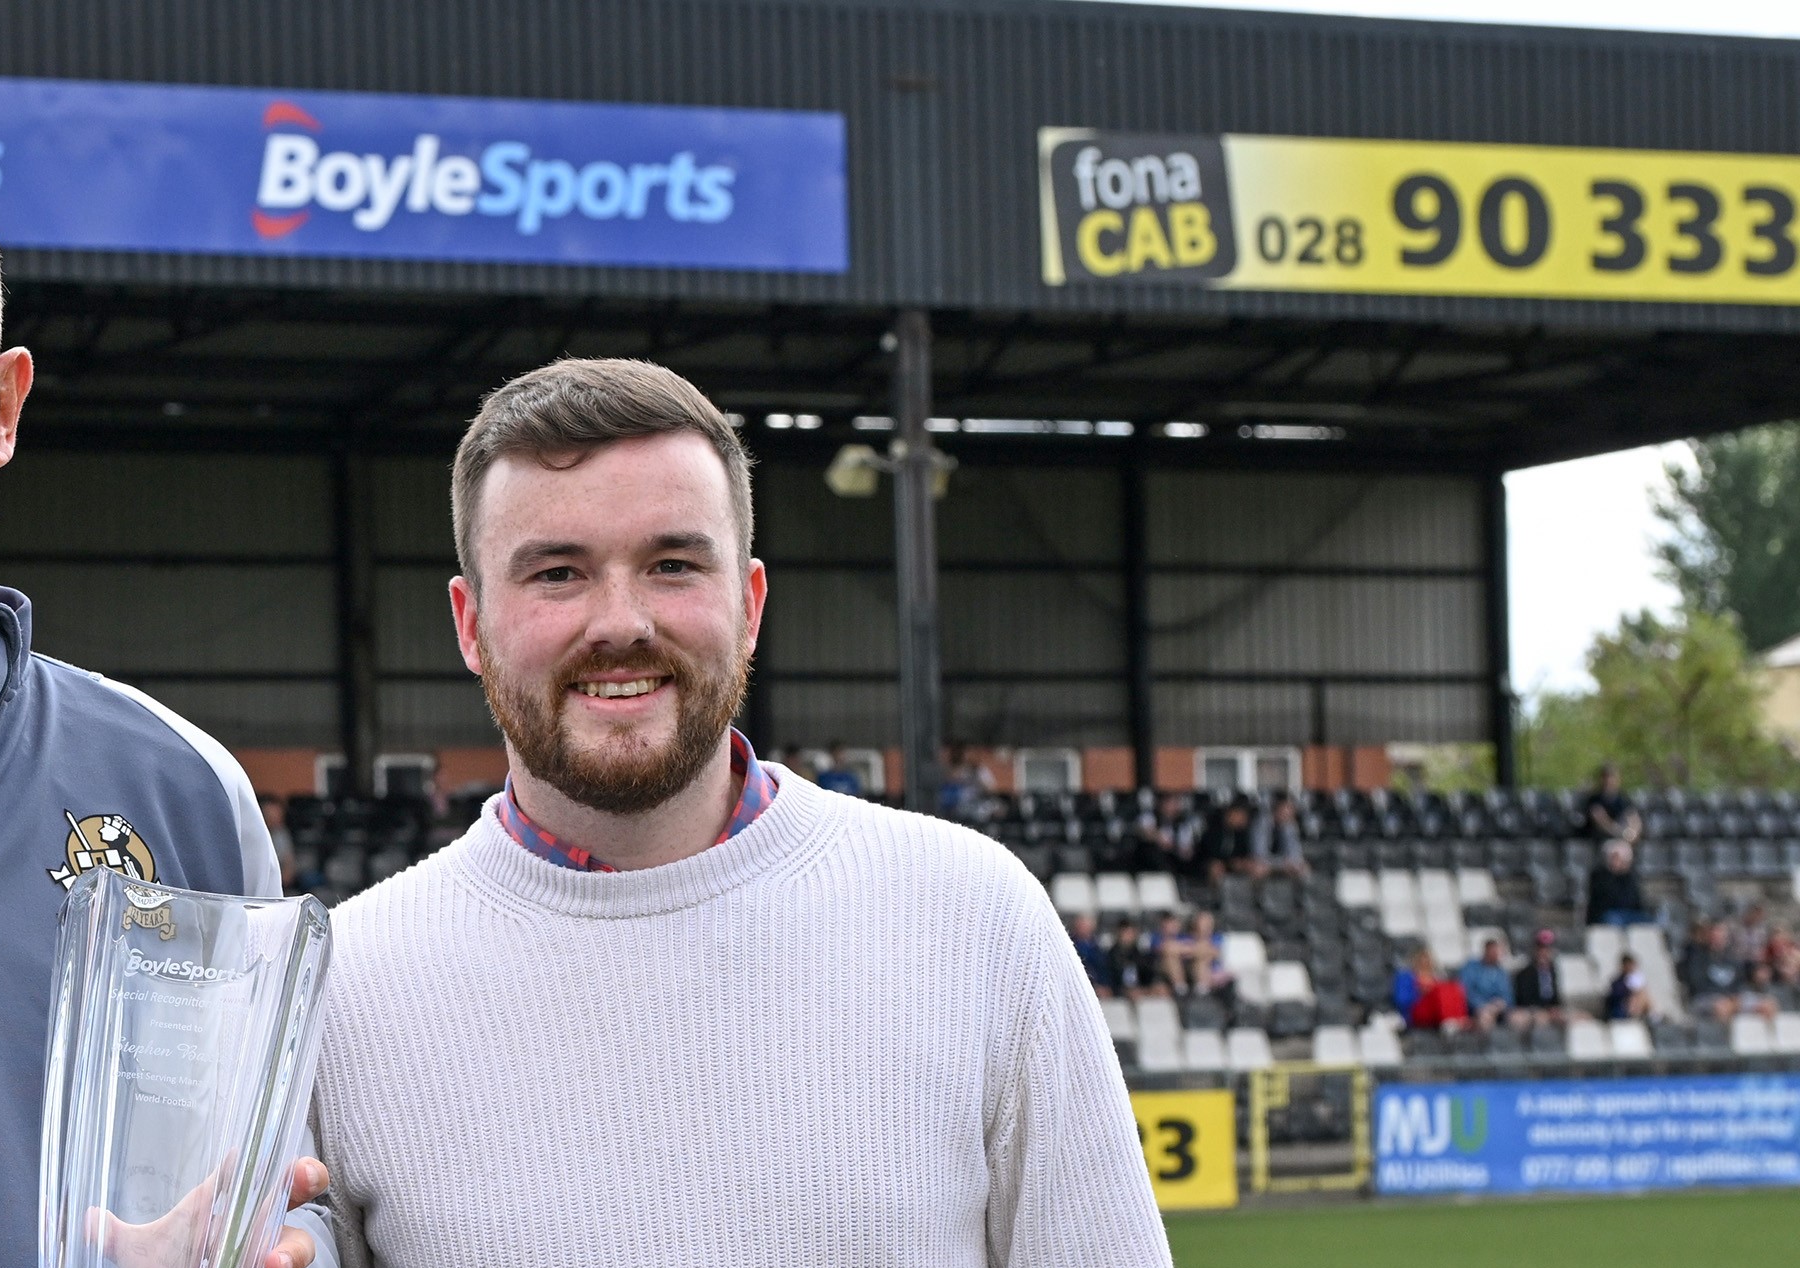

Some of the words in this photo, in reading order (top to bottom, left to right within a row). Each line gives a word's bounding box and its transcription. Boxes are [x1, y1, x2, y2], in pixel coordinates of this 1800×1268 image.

[257, 134, 736, 236] BoyleSports
[1073, 147, 1201, 209] fona
[1076, 204, 1218, 277] CAB
[1256, 215, 1365, 267] 028
[1390, 172, 1553, 270] 90
[1588, 179, 1800, 278] 333
[140, 910, 164, 926] YEARS
[126, 954, 245, 982] BoyleSports
[150, 990, 214, 1009] Recognitio
[150, 1019, 192, 1032] Presented
[194, 1024, 204, 1033] to
[114, 1070, 144, 1081] ongest
[145, 1072, 176, 1085] Serving
[135, 1093, 160, 1104] World
[1378, 1095, 1489, 1156] MJU
[1136, 1118, 1198, 1183] 3
